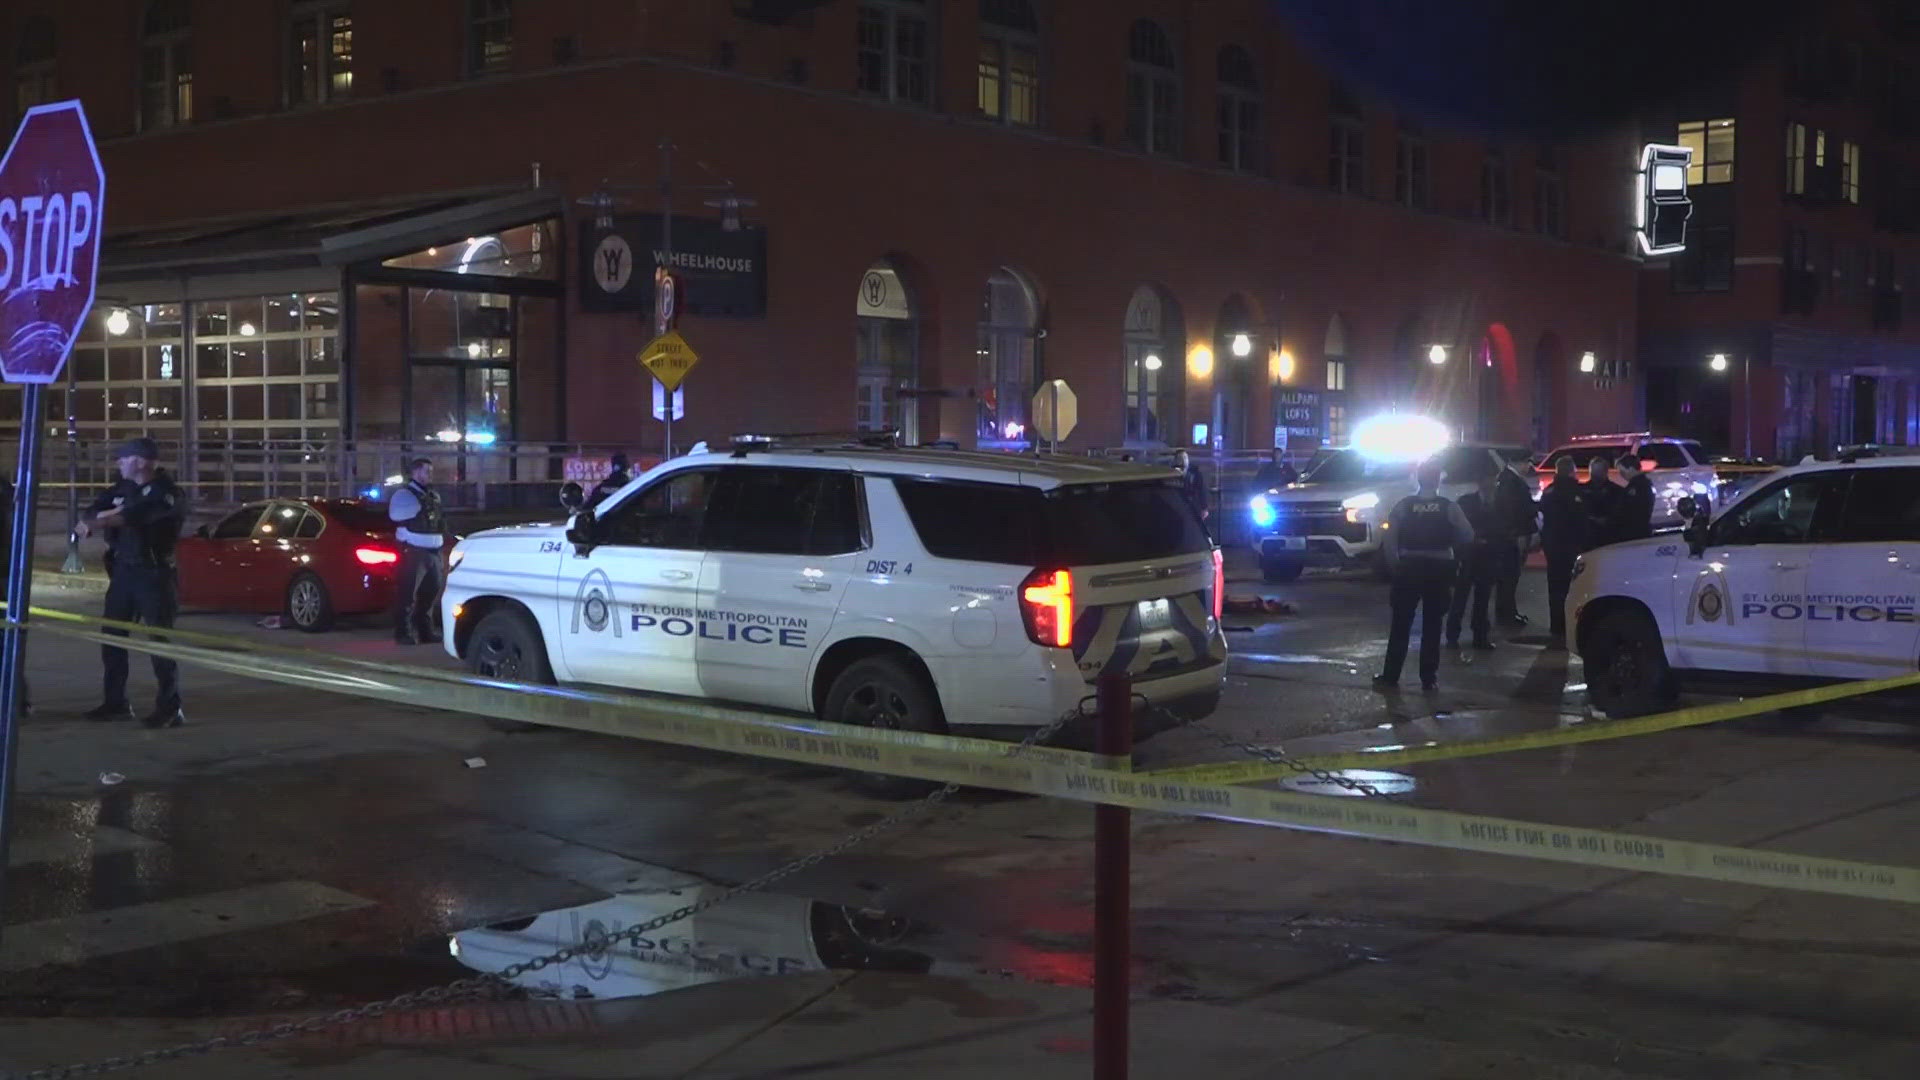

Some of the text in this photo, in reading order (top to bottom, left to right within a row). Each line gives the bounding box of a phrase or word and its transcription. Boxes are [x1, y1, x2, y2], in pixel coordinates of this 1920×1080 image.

[0, 190, 93, 291] STOP
[652, 250, 753, 273] WHEELHOUSE
[650, 359, 665, 368] NOT
[1285, 407, 1310, 421] LOFTS
[1412, 503, 1441, 513] POLICE
[539, 541, 562, 554] 134
[866, 559, 913, 576] DIST. 4
[1764, 594, 1801, 603] LOUIS
[1806, 594, 1916, 605] METROPOLITAN
[653, 605, 693, 618] LOUIS
[697, 610, 808, 629] METROPOLITAN
[1742, 603, 1915, 623] POLICE
[631, 615, 807, 648] POLICE
